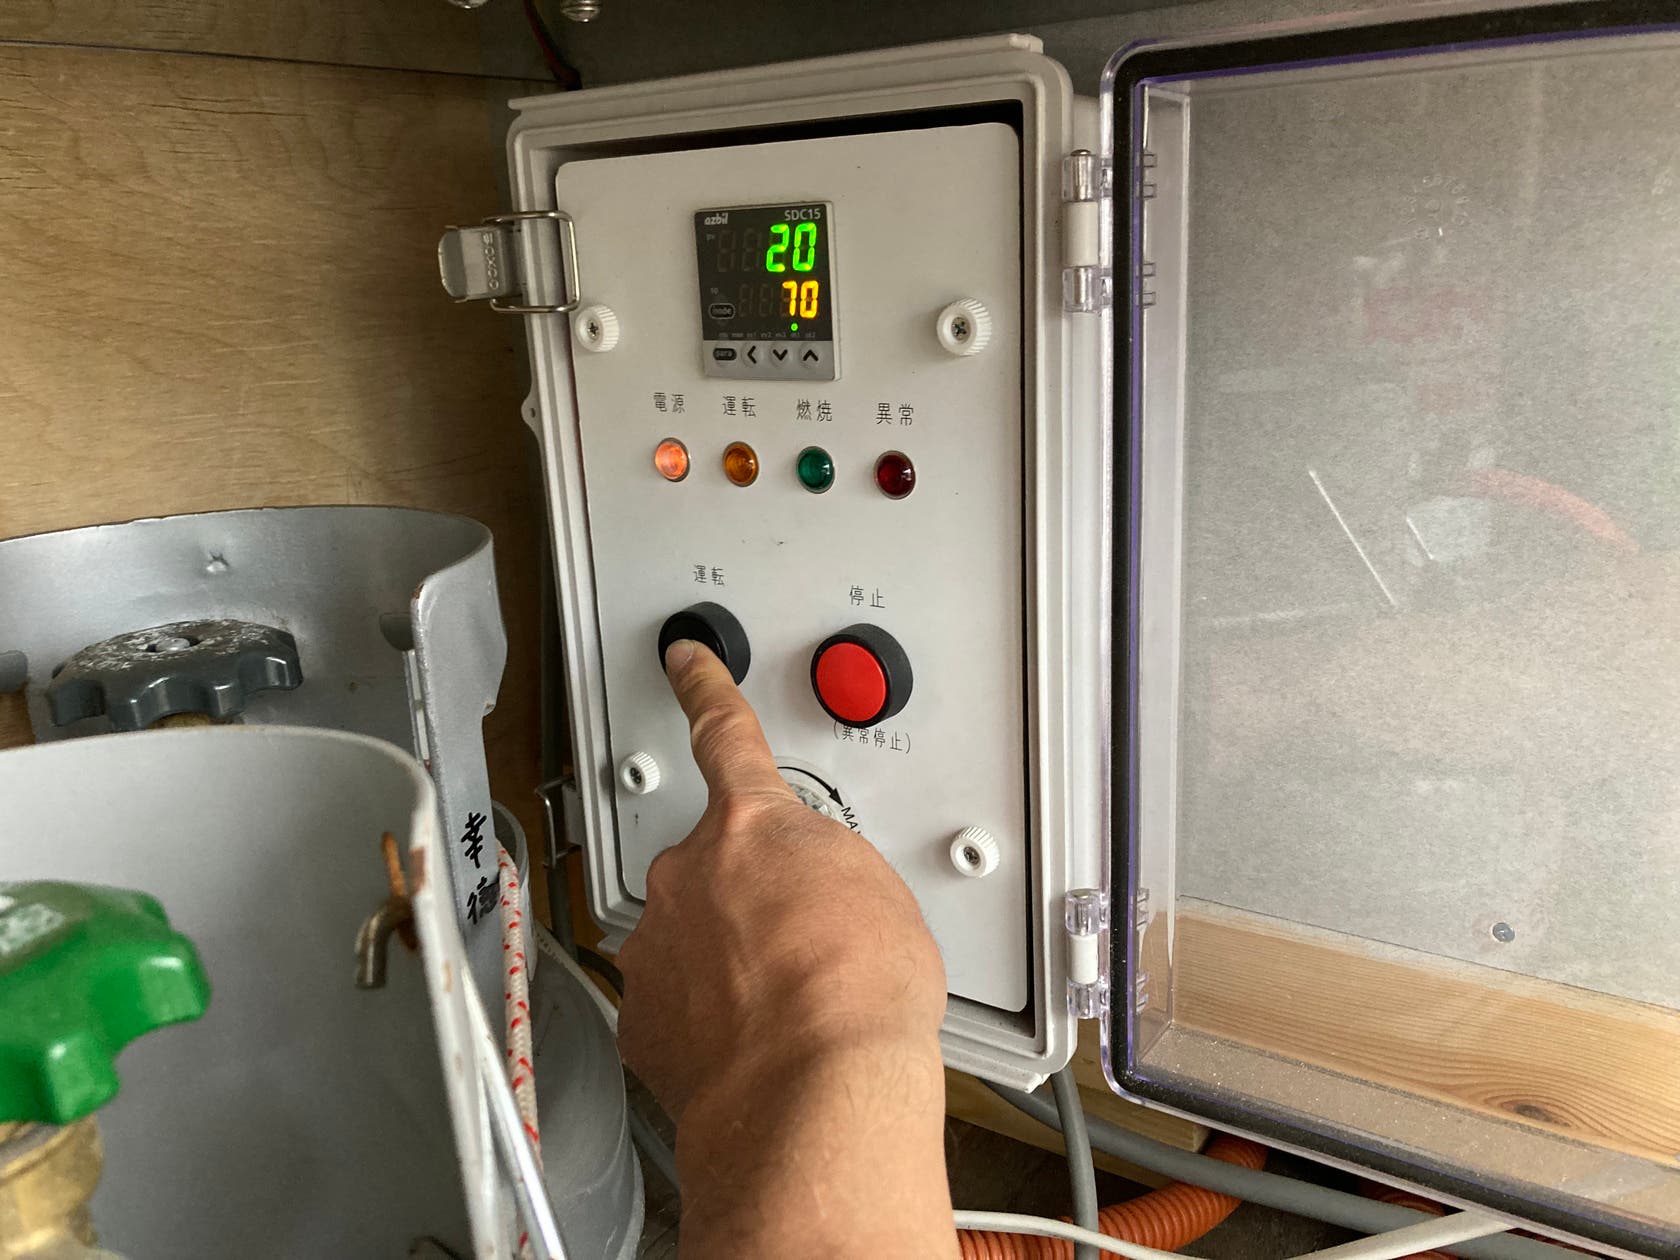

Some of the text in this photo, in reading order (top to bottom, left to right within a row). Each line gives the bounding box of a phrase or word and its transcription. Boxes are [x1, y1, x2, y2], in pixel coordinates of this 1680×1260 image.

[704, 212, 729, 226] azbil
[784, 208, 822, 221] SDC15
[766, 222, 817, 273] 20
[782, 280, 819, 319] 70
[653, 391, 685, 414] 電源
[722, 395, 756, 417] 運転
[796, 399, 833, 422] 燃焼
[876, 402, 914, 426] 異常
[692, 564, 725, 586] 運転
[849, 584, 886, 609] 停止
[841, 806, 861, 834] MA
